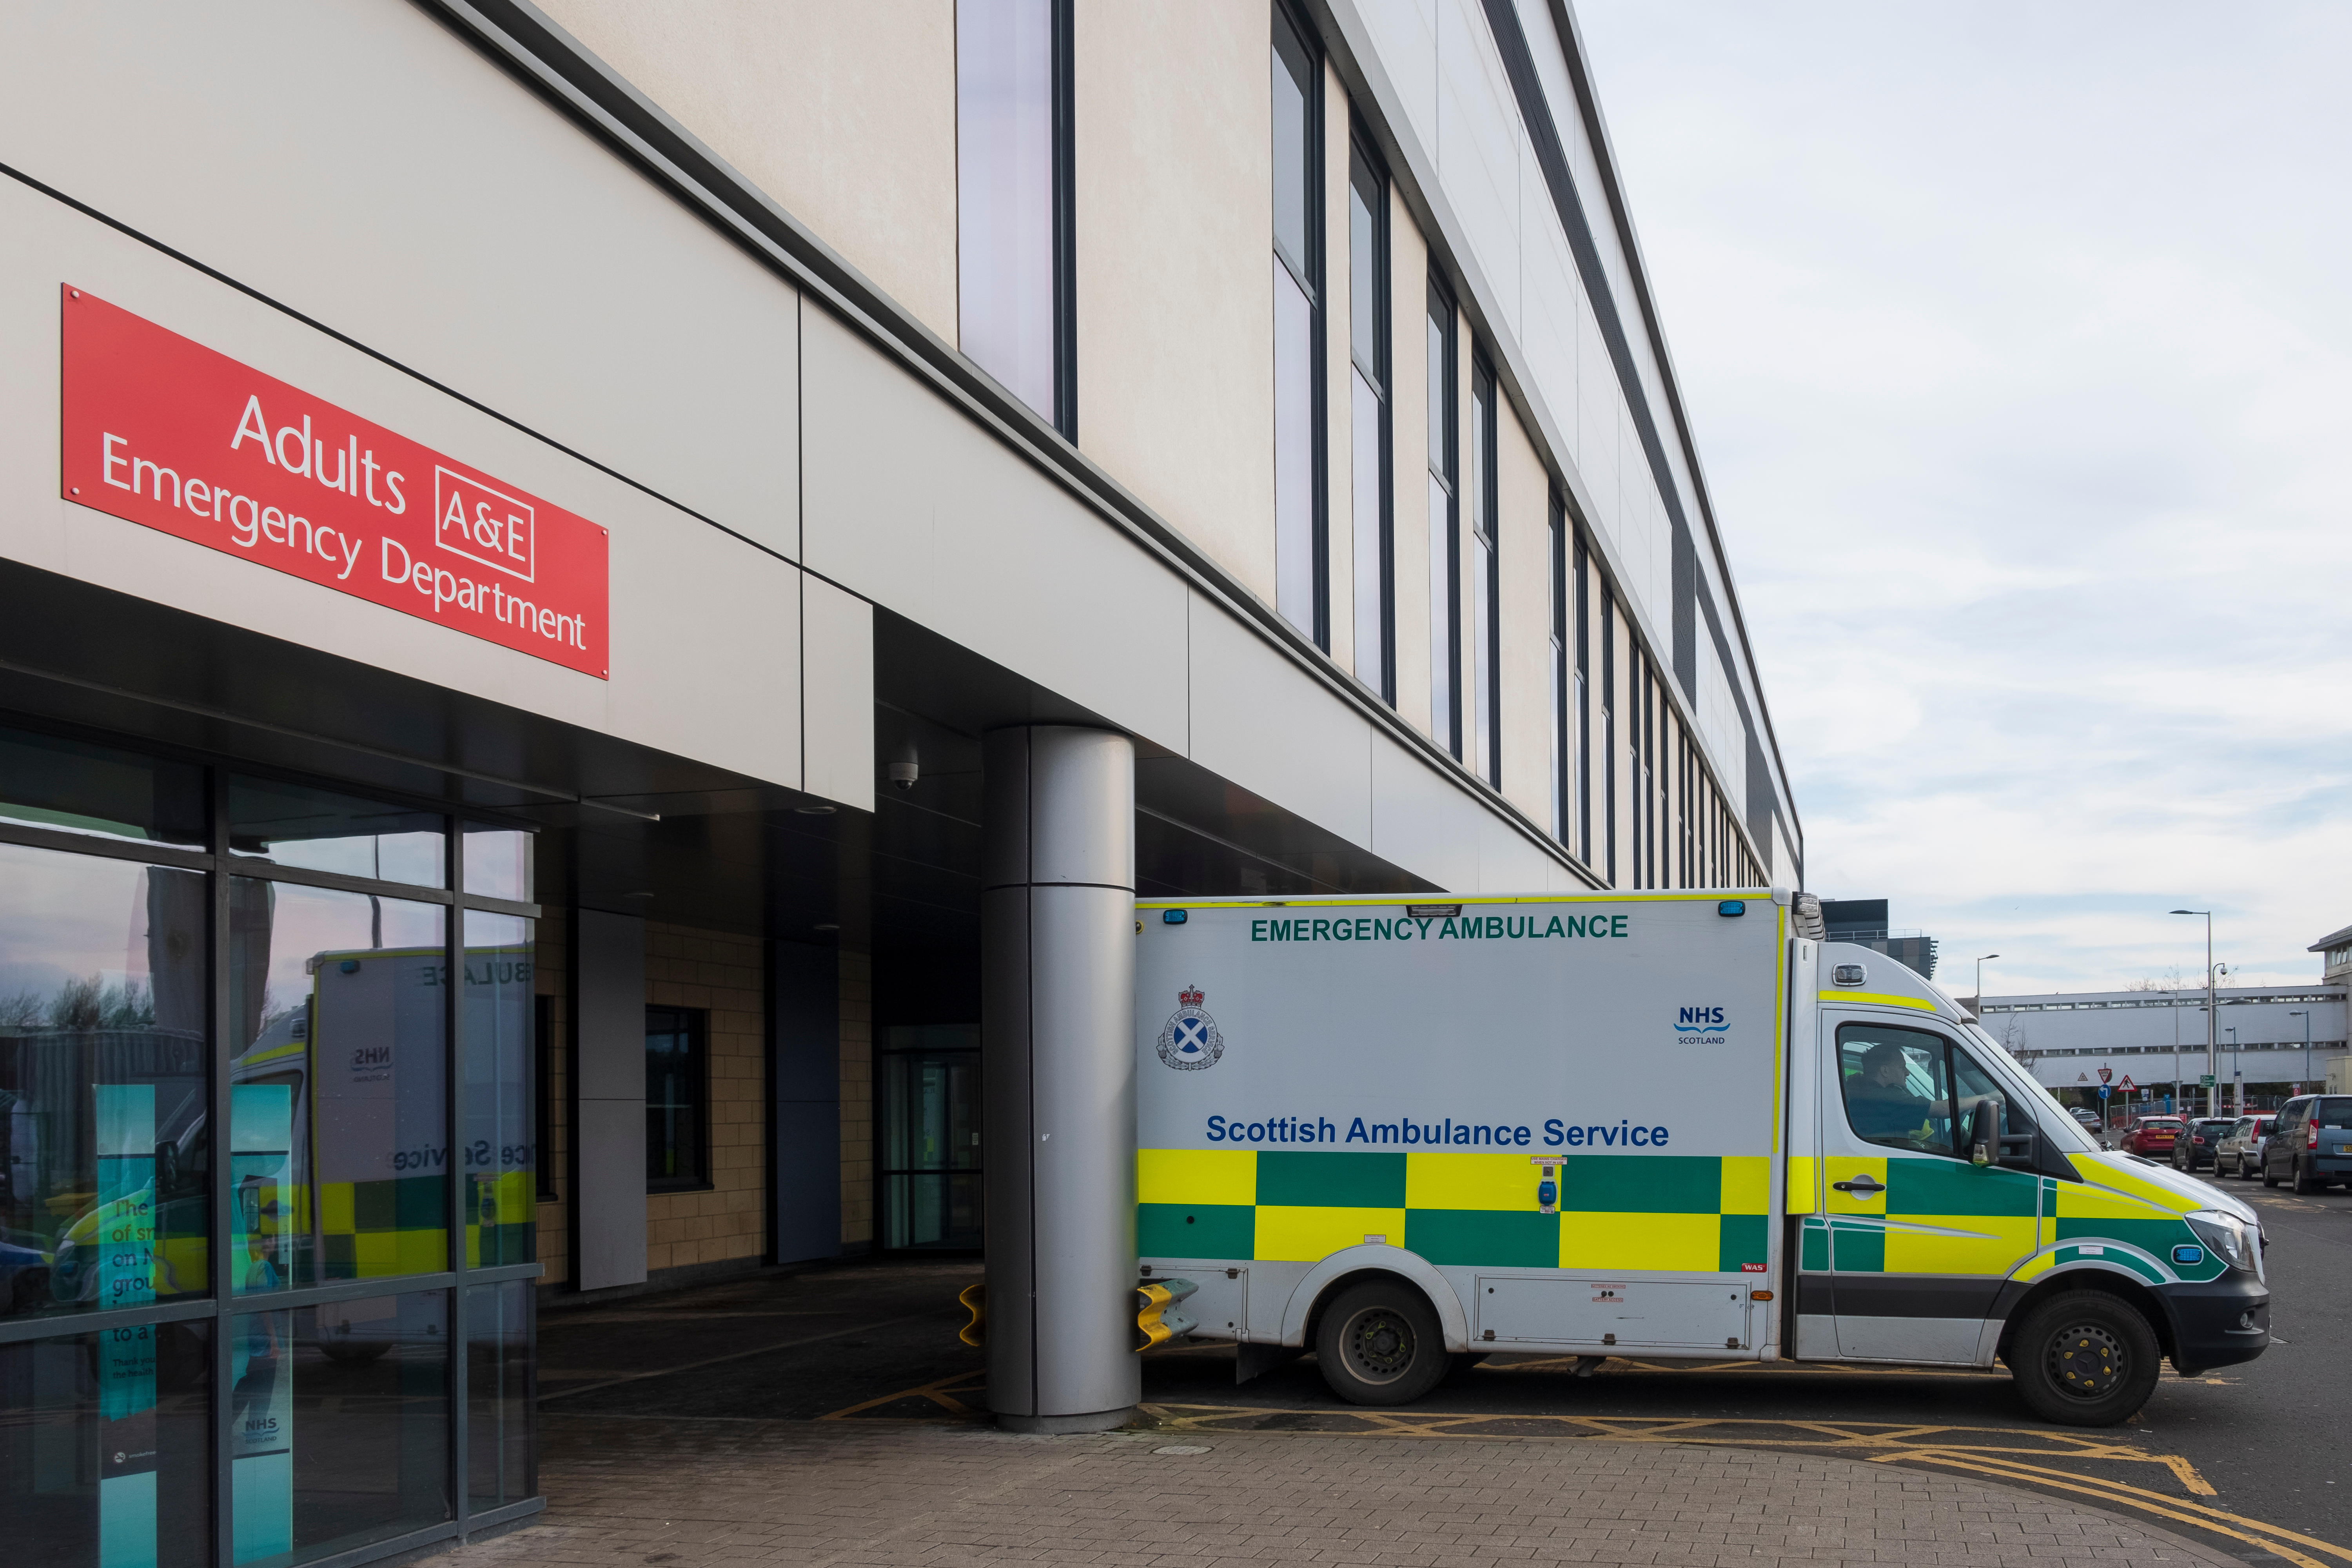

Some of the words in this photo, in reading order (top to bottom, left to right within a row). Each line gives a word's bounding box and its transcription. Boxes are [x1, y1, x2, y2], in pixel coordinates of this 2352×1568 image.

[230, 394, 405, 514] Adults
[442, 490, 526, 562] A&E
[103, 432, 362, 579] Emergency
[381, 536, 586, 650] Department
[1251, 918, 1433, 942] EMERGENCY
[1438, 915, 1628, 940] AMBULANCE
[1680, 1007, 1724, 1024] NHS
[1166, 1021, 1179, 1055] SCOTTISH
[1173, 1010, 1212, 1026] AMBULANCE
[1201, 1026, 1216, 1056] SERVICE
[1206, 1116, 1336, 1143] Scottish
[1345, 1117, 1532, 1146] Ambulance
[1543, 1118, 1670, 1147] Service
[111, 1200, 148, 1217] The
[112, 1224, 131, 1242] of
[113, 1253, 137, 1267] on
[113, 1328, 132, 1342] to
[138, 1327, 149, 1340] a
[113, 1357, 138, 1367] Thank
[140, 1356, 156, 1366] you
[127, 1367, 154, 1377] health
[245, 1418, 276, 1432] NHS
